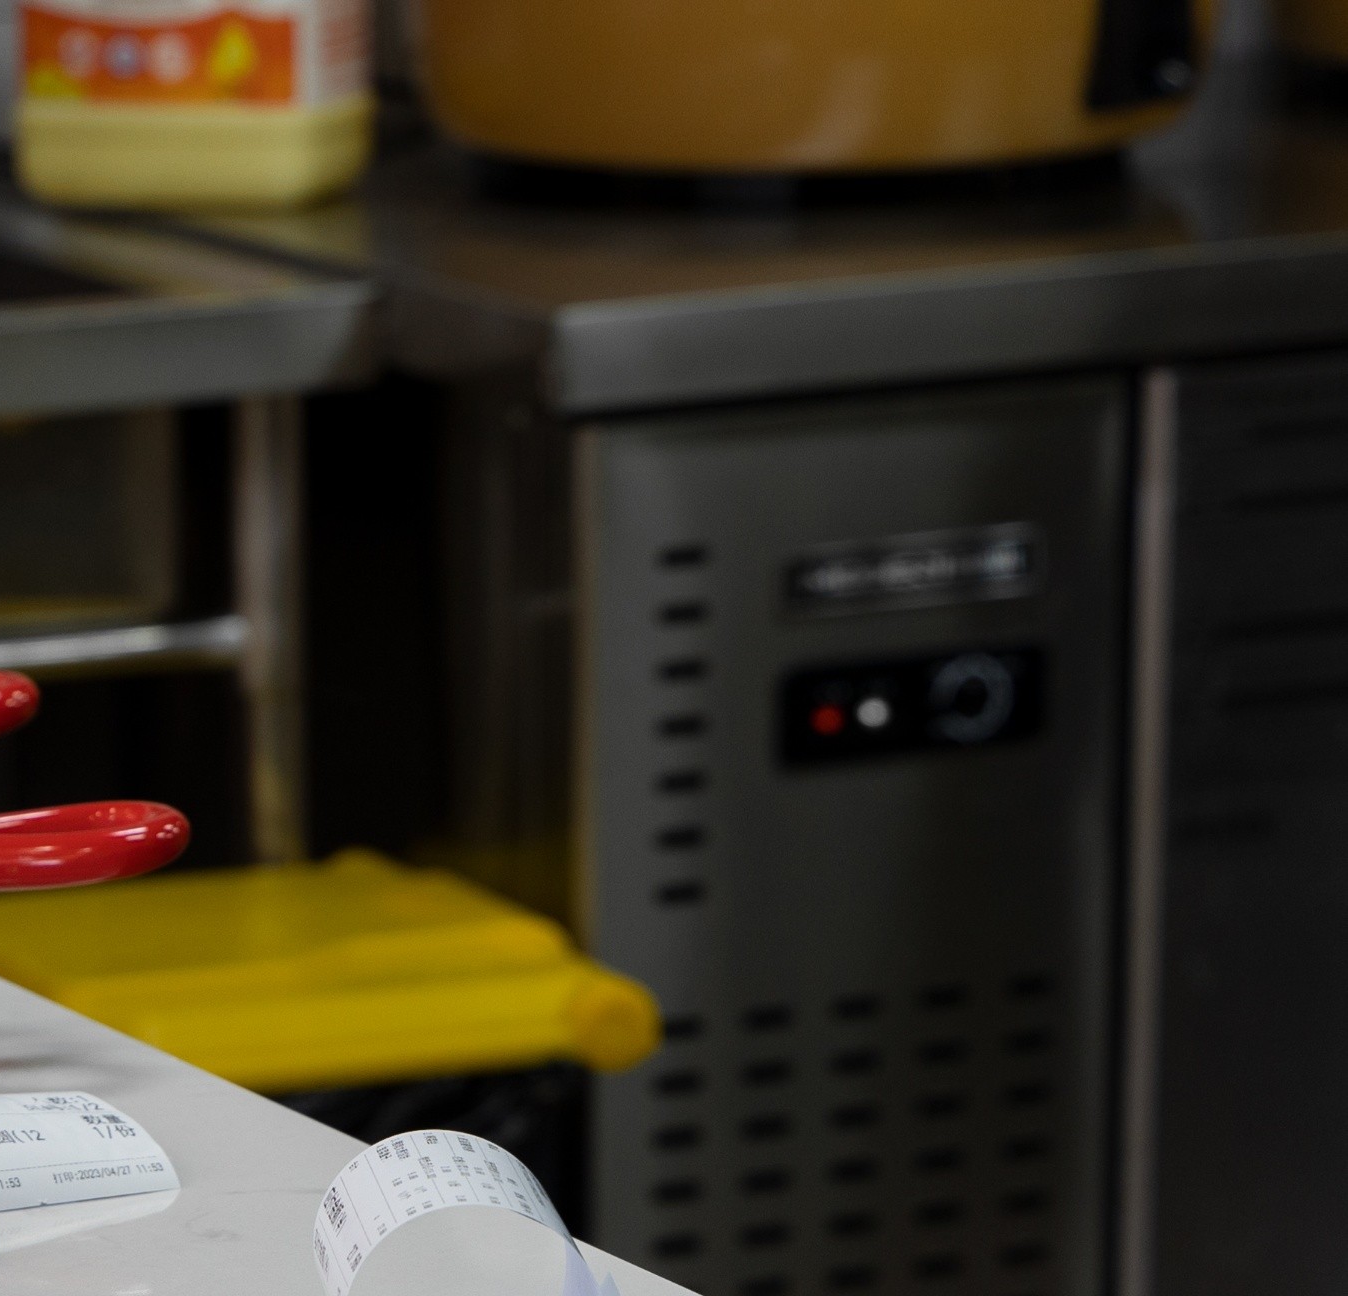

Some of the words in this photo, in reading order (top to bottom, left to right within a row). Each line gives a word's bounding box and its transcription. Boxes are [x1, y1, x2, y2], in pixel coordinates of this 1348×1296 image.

[80, 1113, 126, 1125] 数量
[91, 1124, 137, 1139] 1/份
[51, 1164, 132, 1184] 打印:2023/04/27
[136, 1161, 164, 1174] 11:53
